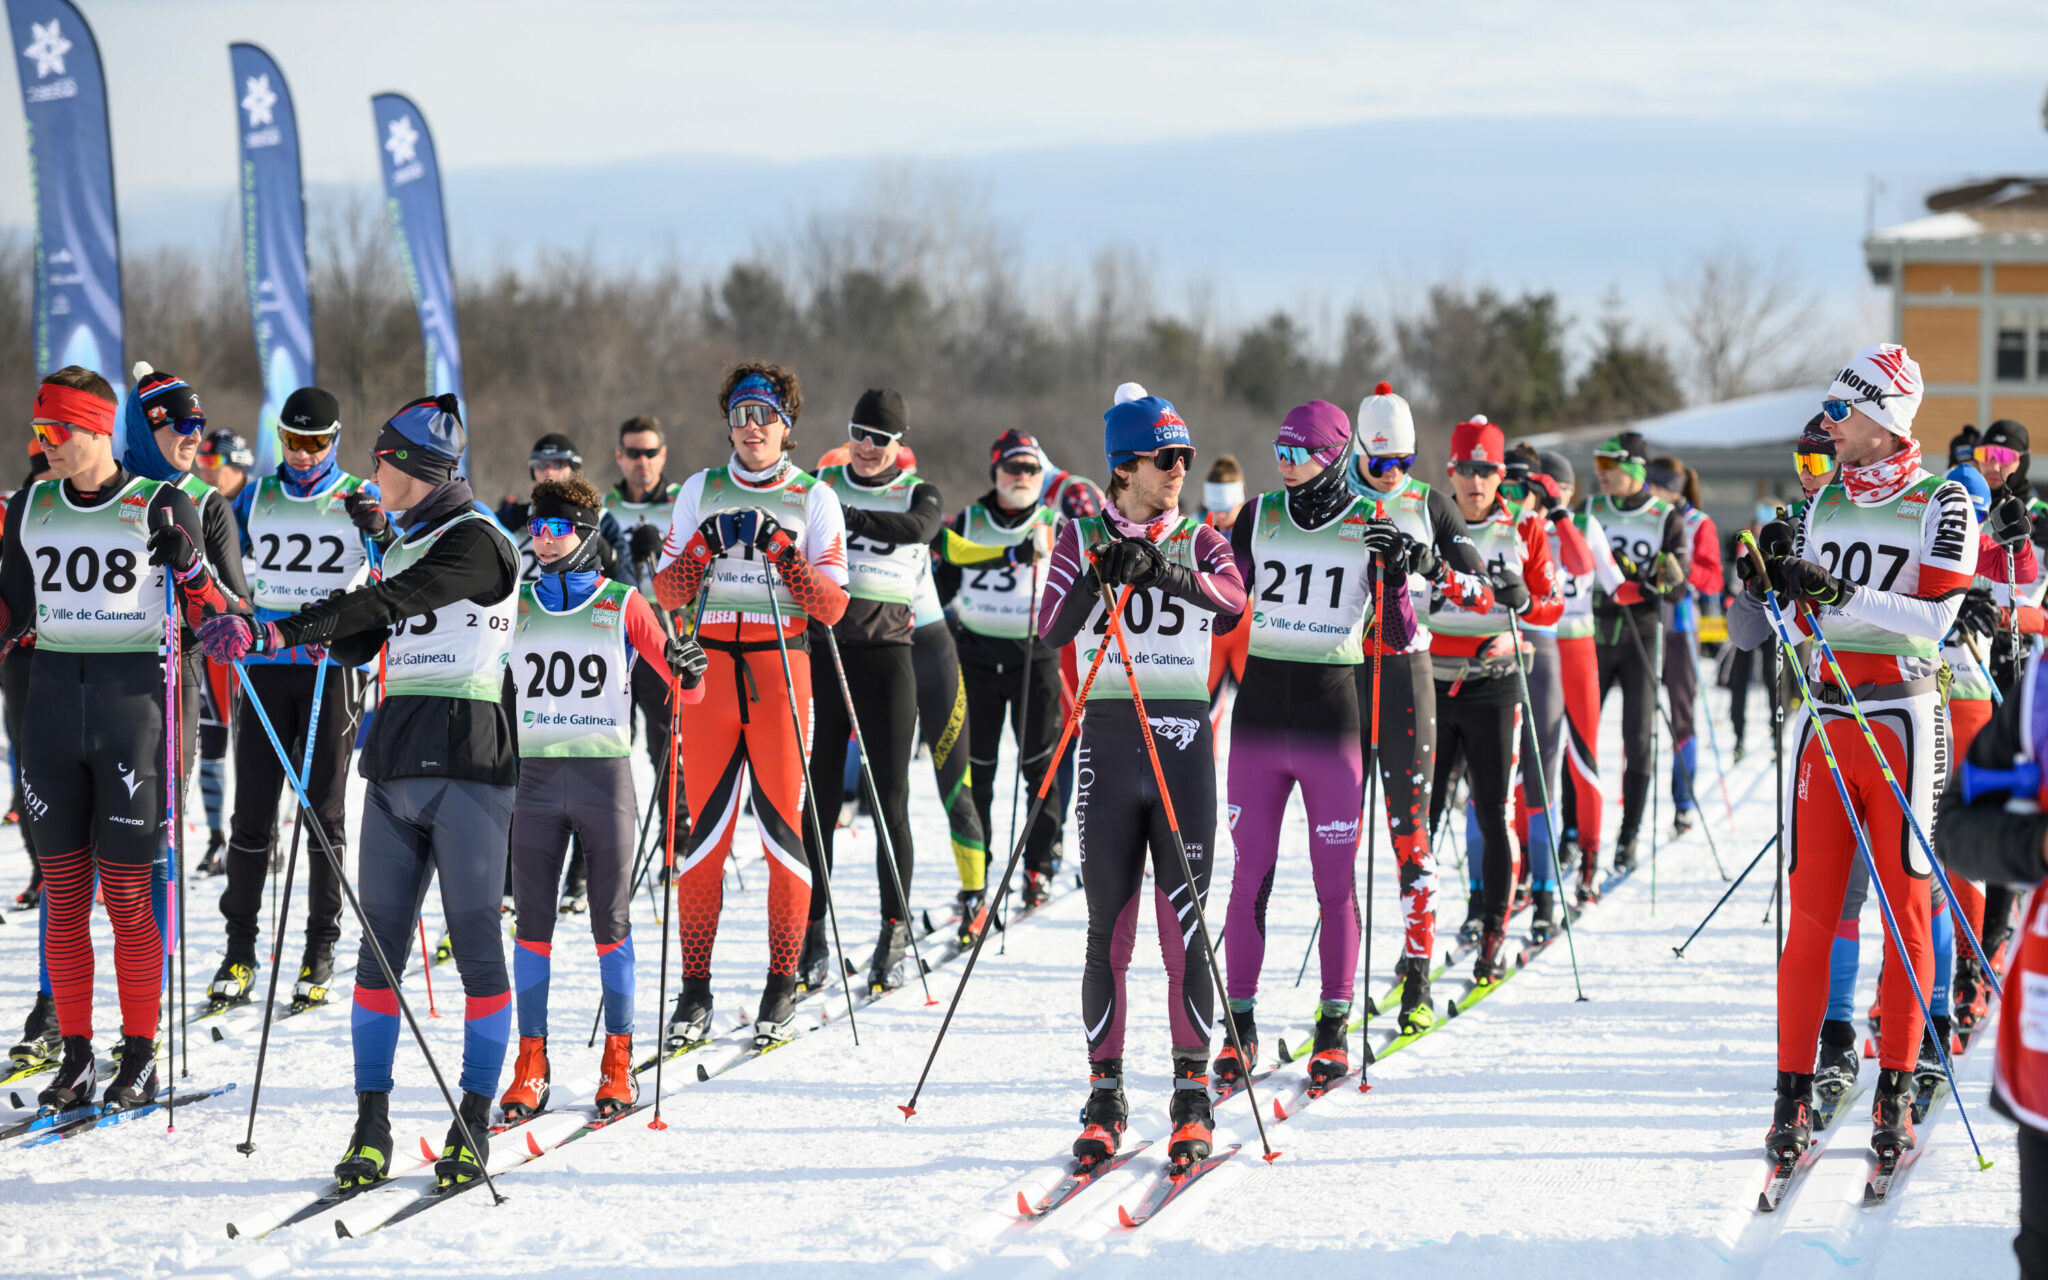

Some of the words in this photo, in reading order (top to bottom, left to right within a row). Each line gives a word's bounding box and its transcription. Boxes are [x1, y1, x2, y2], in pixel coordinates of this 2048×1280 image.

[1896, 506, 1923, 517] LOPPET
[1930, 508, 1968, 562] TEAM
[259, 533, 344, 573] 222
[35, 545, 137, 594] 208
[717, 573, 738, 583] Ville
[741, 573, 755, 583] de
[1261, 560, 1345, 609] 211
[270, 584, 291, 595] Ville
[294, 586, 308, 596] de
[51, 608, 74, 621] Ville
[76, 609, 93, 621] de
[94, 609, 147, 622] Gatineau
[591, 614, 618, 625] LOPPET
[466, 613, 478, 627] 2
[488, 616, 510, 632] 03
[1199, 618, 1209, 632] 2
[1270, 617, 1292, 630] Ville
[1293, 620, 1307, 632] de
[403, 652, 456, 665] Gatineau
[1134, 651, 1150, 664] de
[524, 650, 608, 699] 209
[553, 712, 567, 725] de
[109, 815, 144, 826] JAKROO
